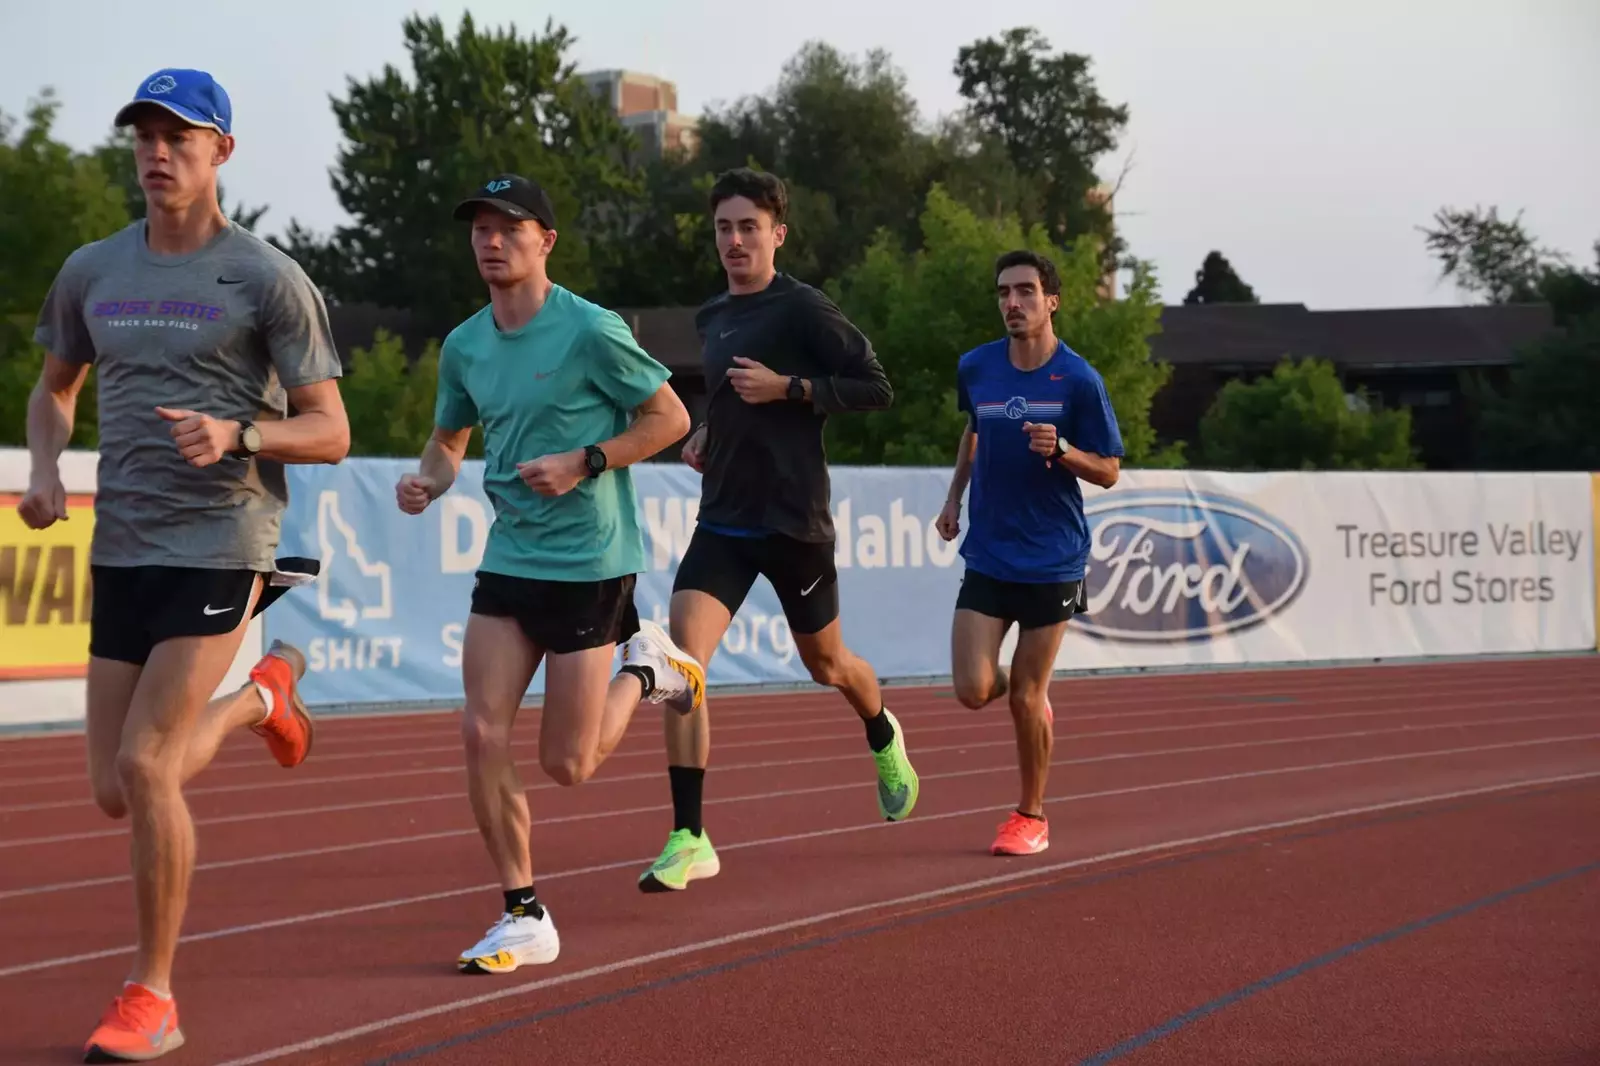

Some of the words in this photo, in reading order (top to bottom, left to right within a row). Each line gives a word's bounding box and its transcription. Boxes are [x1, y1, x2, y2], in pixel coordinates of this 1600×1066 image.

[94, 302, 152, 316] BOISE
[158, 302, 223, 320] STATE
[108, 320, 140, 328] TRACK
[144, 319, 166, 327] AND
[168, 321, 199, 331] FIELD
[1336, 524, 1480, 559] Treasure
[1487, 520, 1582, 562] Valley
[1085, 515, 1250, 616] Ford
[1369, 570, 1443, 606] Ford
[1452, 569, 1555, 605] Stores
[309, 636, 403, 672] SHIFT
